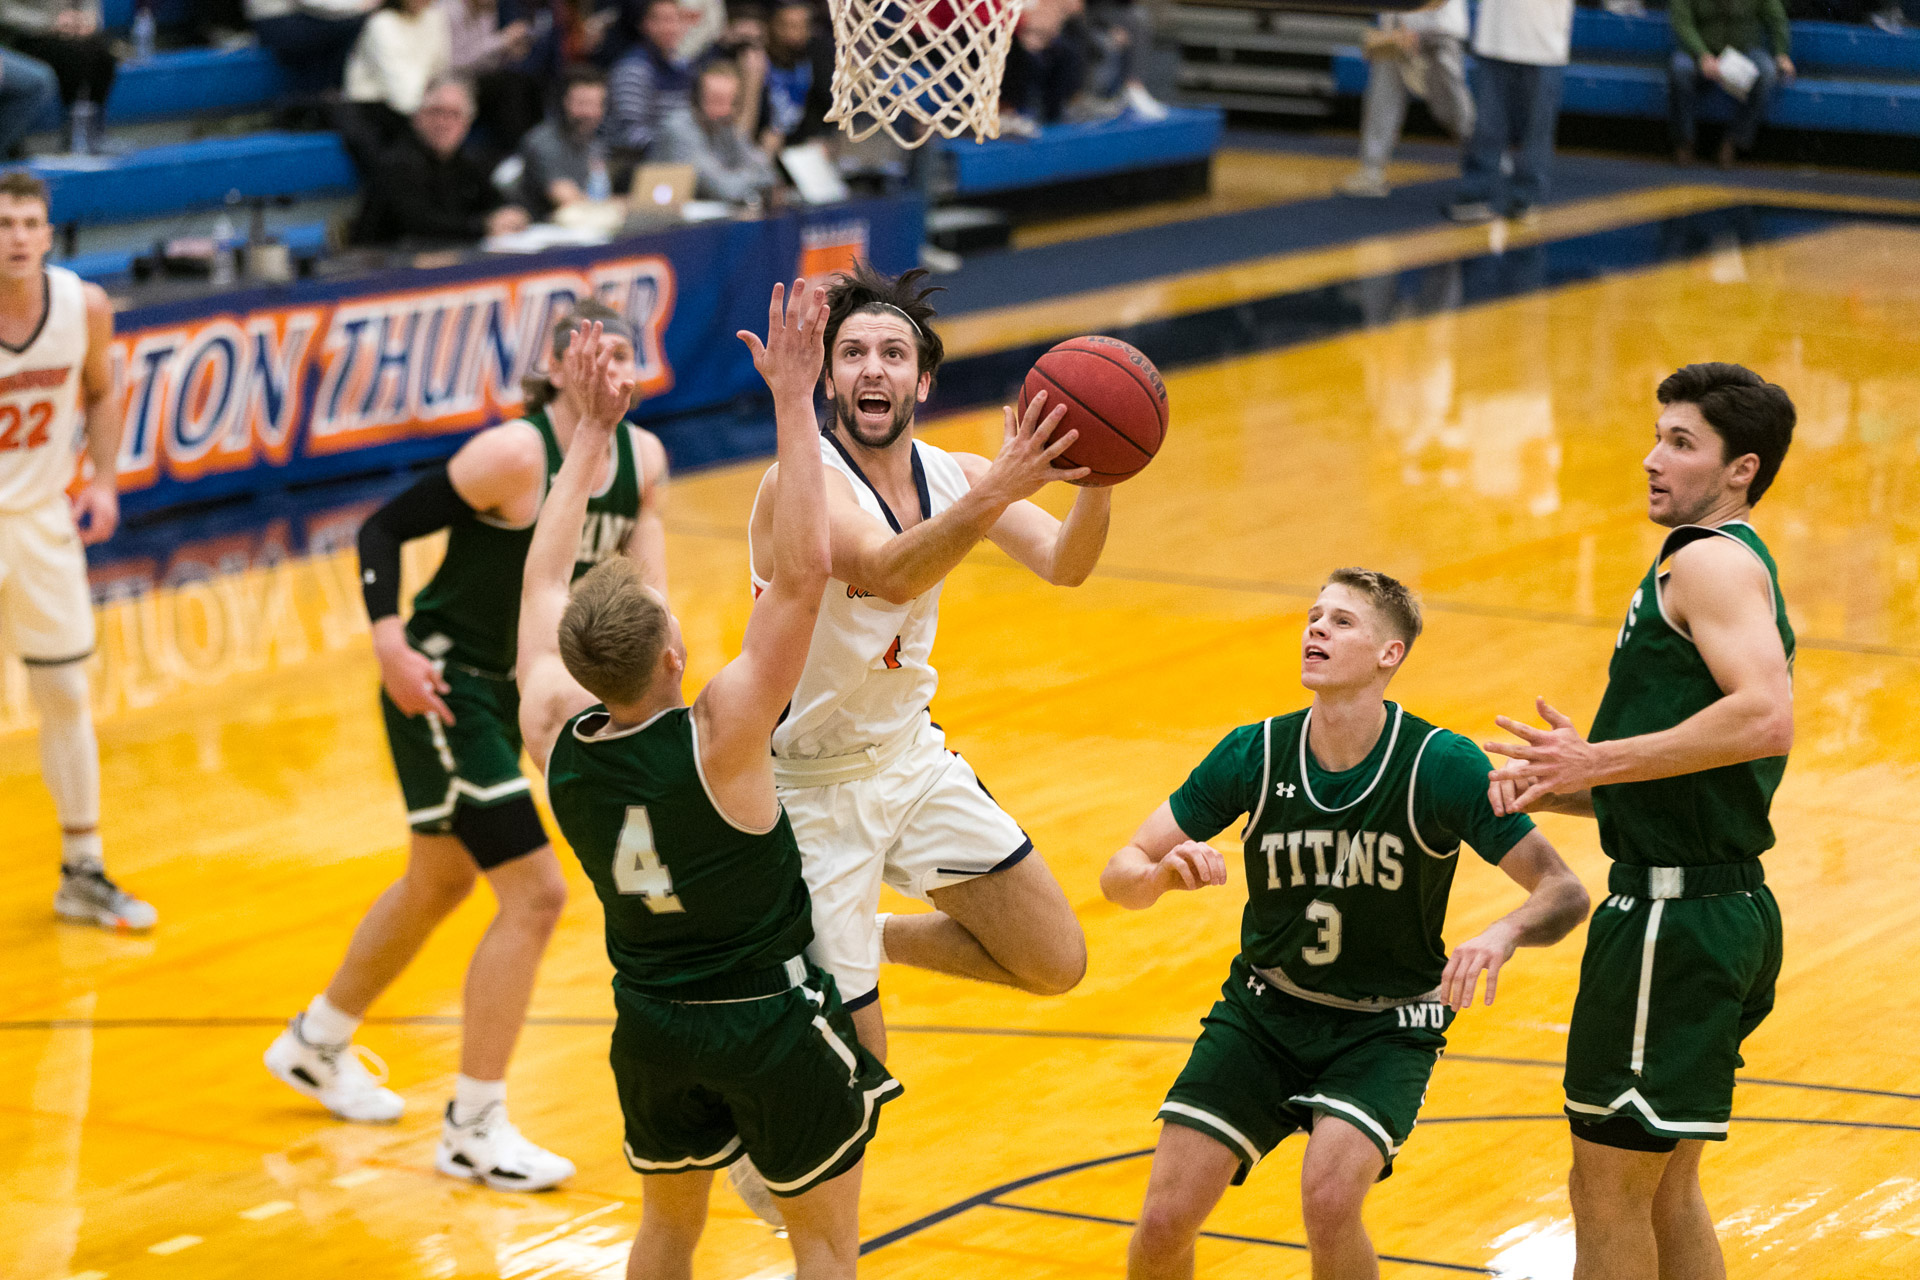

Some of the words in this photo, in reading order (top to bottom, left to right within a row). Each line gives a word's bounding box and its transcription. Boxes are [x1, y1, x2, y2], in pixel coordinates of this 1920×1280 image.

[0, 401, 53, 452] 22
[612, 805, 687, 914] 4
[1260, 829, 1405, 891] TITANS
[1302, 899, 1342, 966] 3
[1396, 1003, 1444, 1029] IWU
